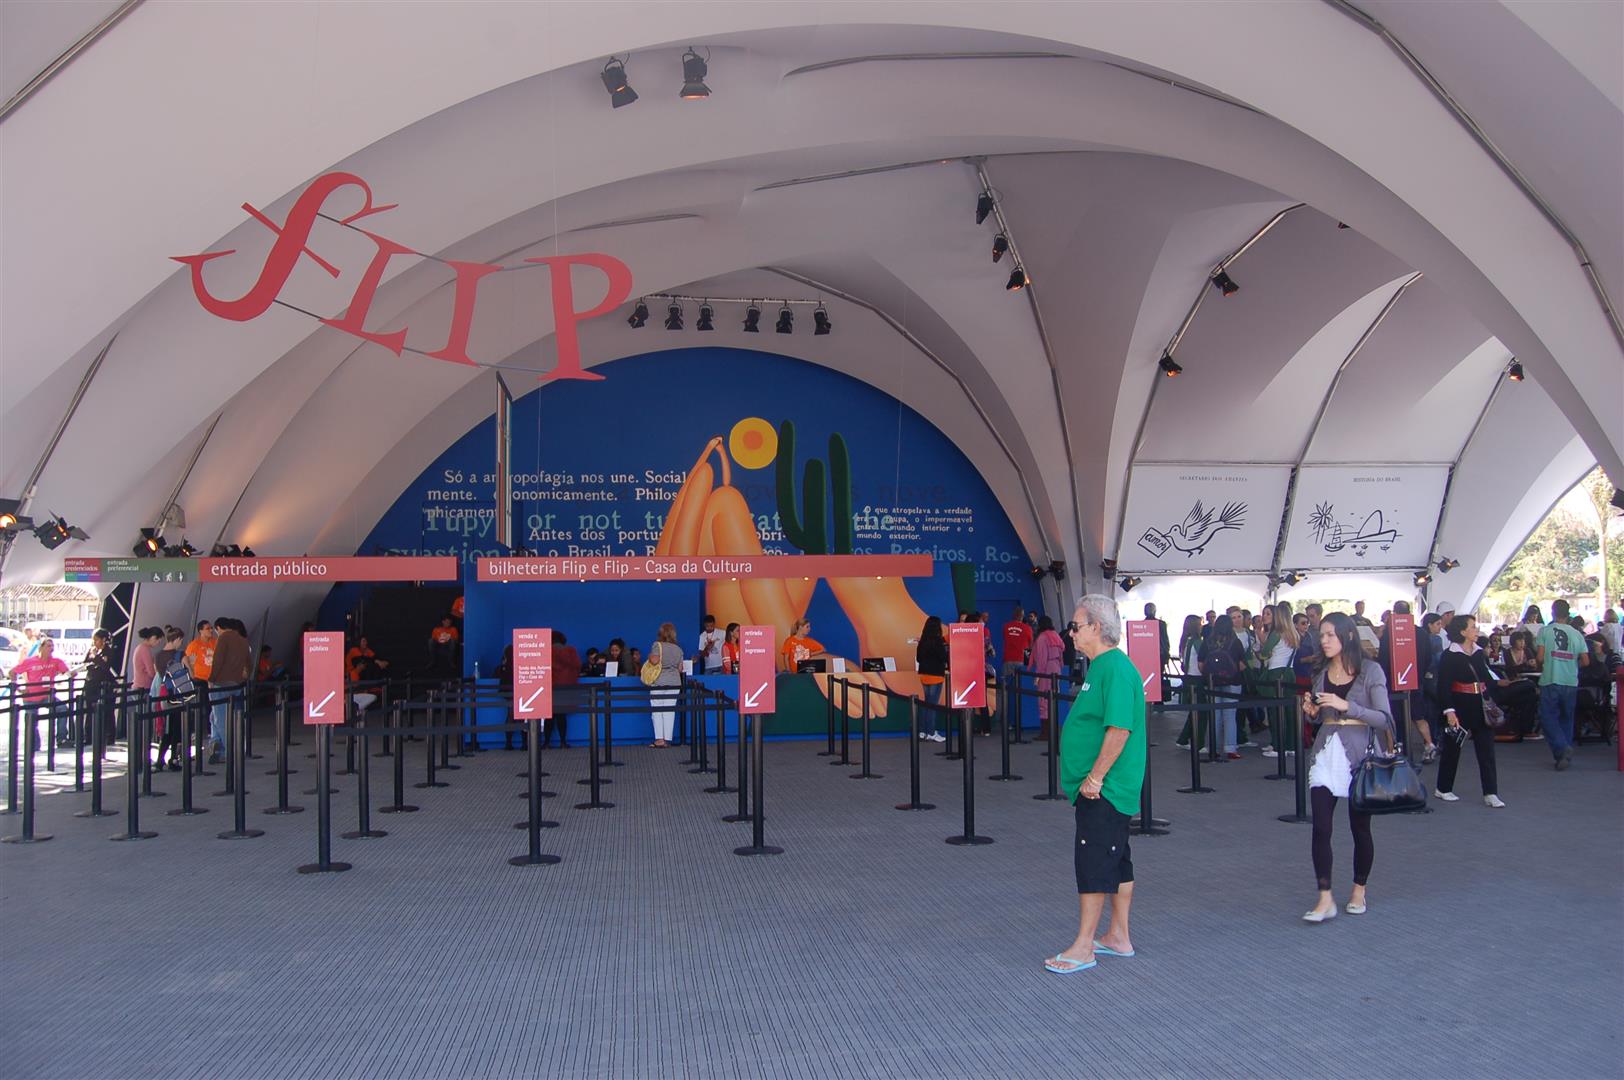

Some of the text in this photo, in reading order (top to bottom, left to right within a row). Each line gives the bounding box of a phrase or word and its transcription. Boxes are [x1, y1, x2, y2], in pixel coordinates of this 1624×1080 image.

[445, 470, 463, 484] Só
[469, 474, 477, 483] a
[581, 474, 604, 483] nos
[611, 474, 639, 483] une.
[427, 490, 477, 500] mente.
[875, 508, 888, 516] que
[892, 506, 931, 516] atropelava
[944, 507, 973, 515] verdade
[527, 513, 556, 530] or
[578, 510, 621, 530] not
[852, 506, 895, 531] the
[922, 524, 950, 532] interior
[529, 529, 572, 541] Antes
[580, 528, 605, 540] dos
[857, 531, 922, 540] mundo exterior.
[985, 545, 1019, 563] Ro-
[211, 561, 327, 579] entrada público
[489, 561, 557, 576] bilheteria
[562, 560, 587, 578] Flip
[591, 563, 600, 575] e
[604, 560, 629, 577] Flip
[645, 560, 677, 574] Casa
[681, 560, 698, 573] da
[703, 559, 752, 573] Cultura
[952, 626, 979, 634] preferencial
[309, 645, 329, 653] público
